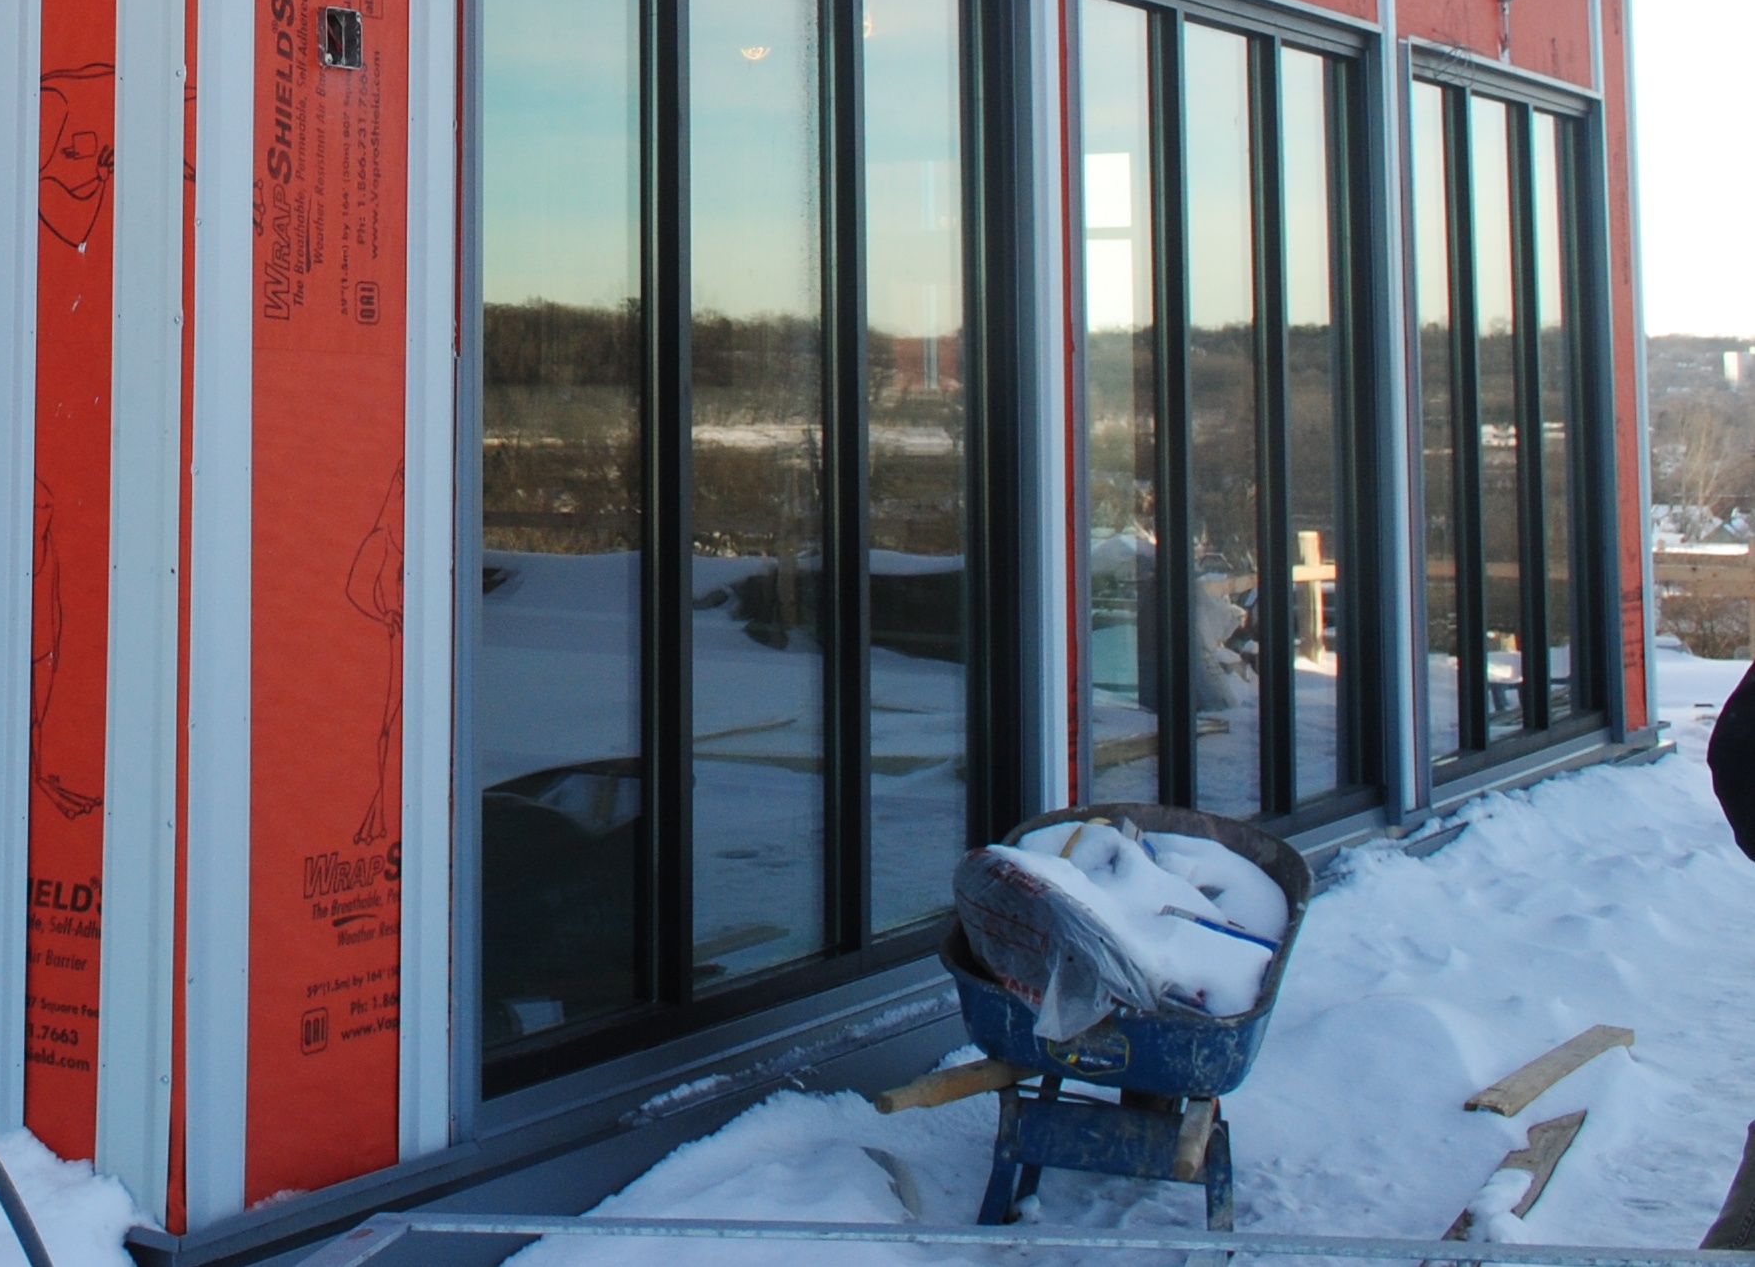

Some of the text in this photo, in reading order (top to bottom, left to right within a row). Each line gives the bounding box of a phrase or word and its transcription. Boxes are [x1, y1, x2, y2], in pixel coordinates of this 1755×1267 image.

[316, 103, 326, 125] Air
[315, 128, 325, 197] Resistant
[372, 51, 381, 259] www.VaproShield.com
[314, 200, 325, 265] Weather
[357, 216, 366, 245] Ph:
[294, 279, 304, 307] The
[312, 904, 329, 919] The
[338, 928, 376, 945] Weather
[45, 949, 87, 971] Barrier
[40, 997, 79, 1016] Square
[351, 1000, 368, 1015] Ph:
